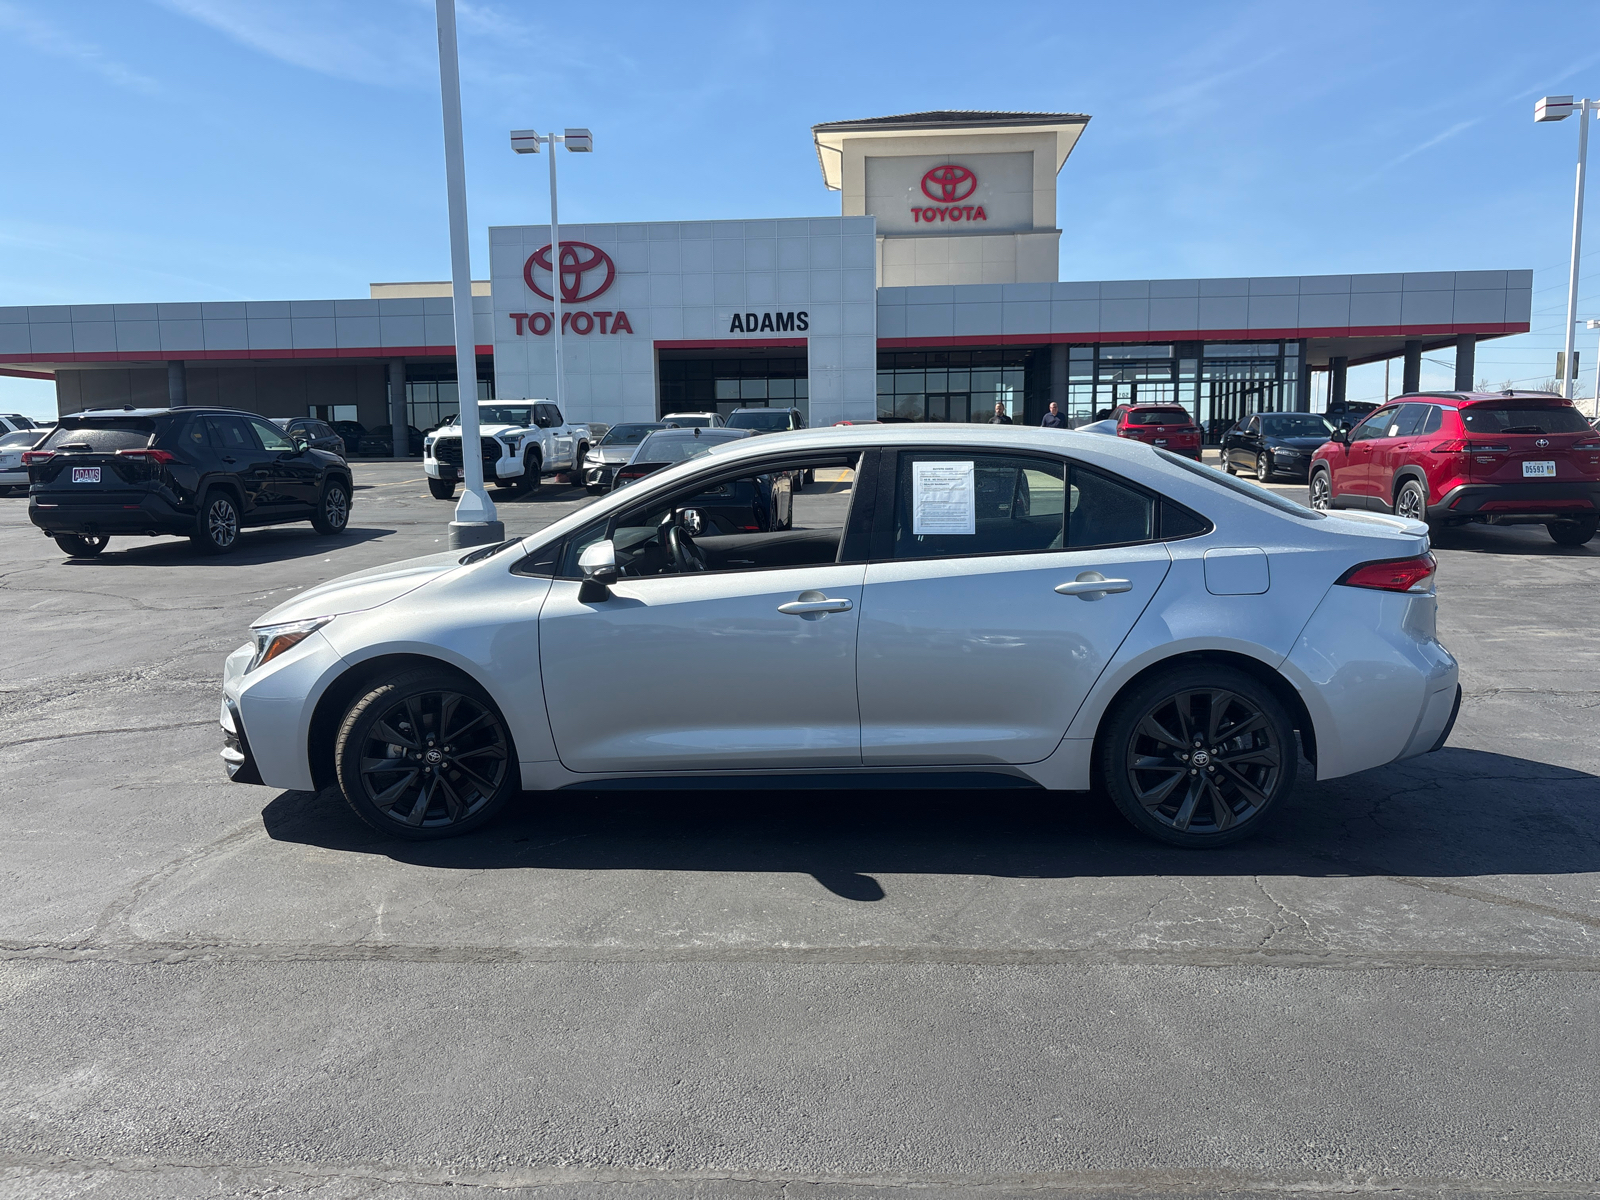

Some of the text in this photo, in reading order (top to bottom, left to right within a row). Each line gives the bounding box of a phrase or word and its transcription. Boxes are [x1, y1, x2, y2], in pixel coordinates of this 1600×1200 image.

[911, 206, 987, 223] TOYOTA
[509, 311, 633, 335] TOYOTA
[729, 311, 810, 333] ADAMS
[75, 470, 99, 480] ADAMS
[1525, 465, 1544, 473] D5593
